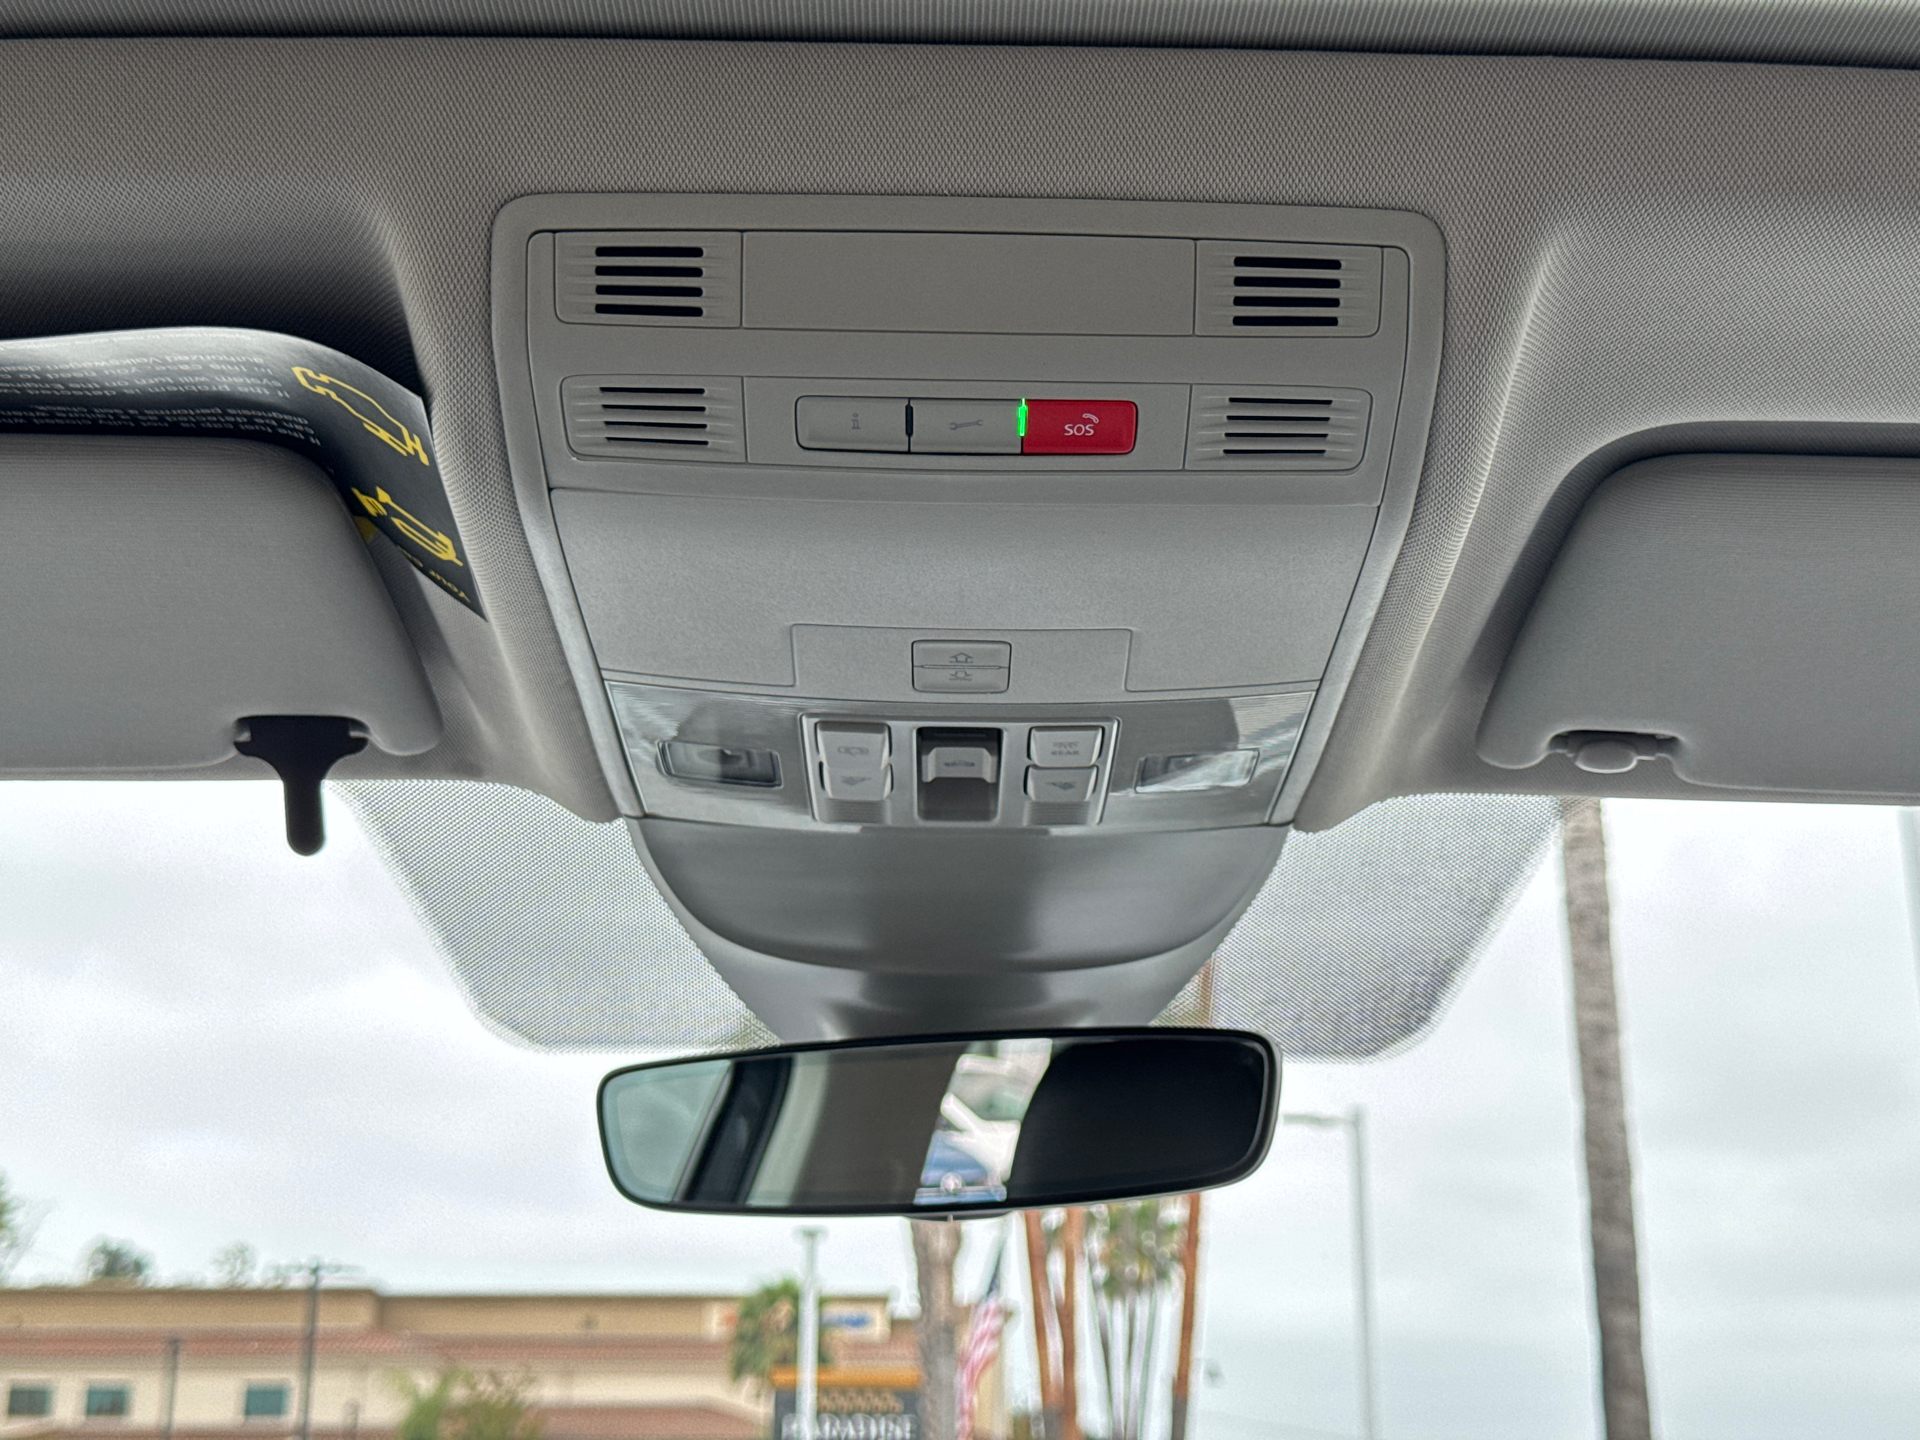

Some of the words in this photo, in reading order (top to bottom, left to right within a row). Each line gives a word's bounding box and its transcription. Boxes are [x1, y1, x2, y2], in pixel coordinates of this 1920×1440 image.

[46, 357, 163, 371] Volkswagen
[165, 354, 265, 365] authorized
[103, 366, 142, 376] you
[148, 364, 203, 373] case,
[209, 362, 248, 372] this
[253, 366, 274, 376] In
[46, 371, 98, 379] need
[134, 377, 175, 385] turn
[179, 376, 209, 384] will
[214, 375, 283, 387] system
[0, 382, 65, 390] Engine
[147, 385, 231, 393] problem
[238, 386, 270, 395] the
[27, 389, 117, 397] detected
[277, 390, 290, 398] If
[1, 410, 51, 418] when
[144, 407, 223, 415] performs
[56, 412, 115, 420] failure
[166, 416, 248, 424] detected
[227, 408, 309, 425] diagnosis
[99, 419, 136, 427] fully
[201, 421, 234, 429] cap
[253, 418, 278, 427] be
[239, 424, 273, 433] fuel
[282, 421, 315, 434] can
[1064, 423, 1095, 436] SOS
[277, 428, 305, 439] the
[309, 436, 321, 446] If
